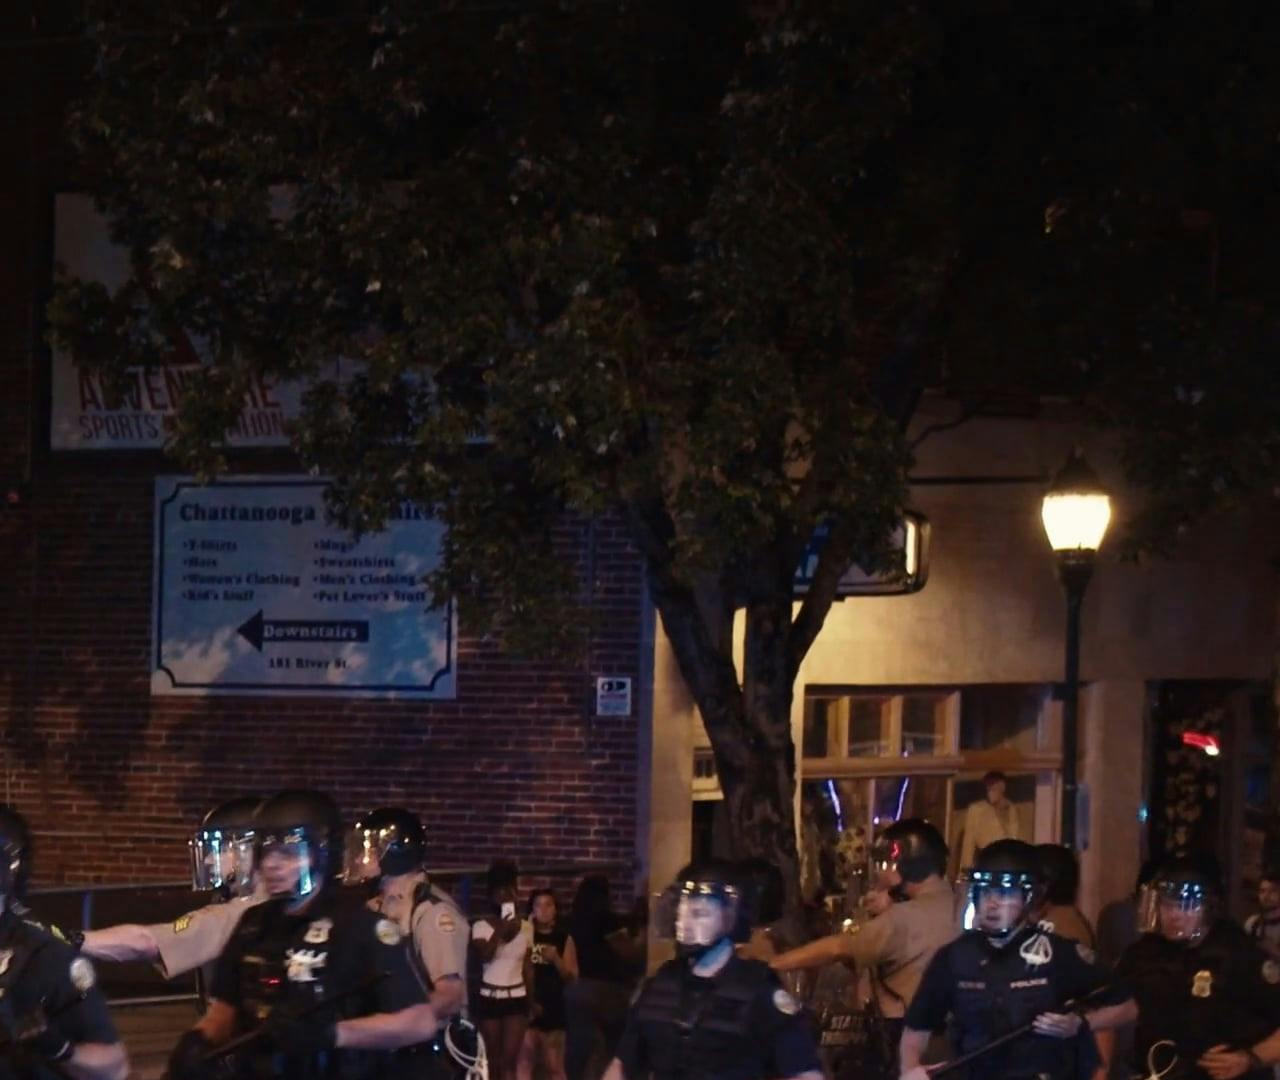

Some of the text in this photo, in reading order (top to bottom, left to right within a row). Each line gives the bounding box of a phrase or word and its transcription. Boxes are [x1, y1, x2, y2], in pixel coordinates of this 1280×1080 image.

[79, 413, 160, 440] SPORTS
[179, 503, 316, 525] Chattanooga
[360, 573, 416, 586] Clothing
[263, 624, 358, 639] Downstairs
